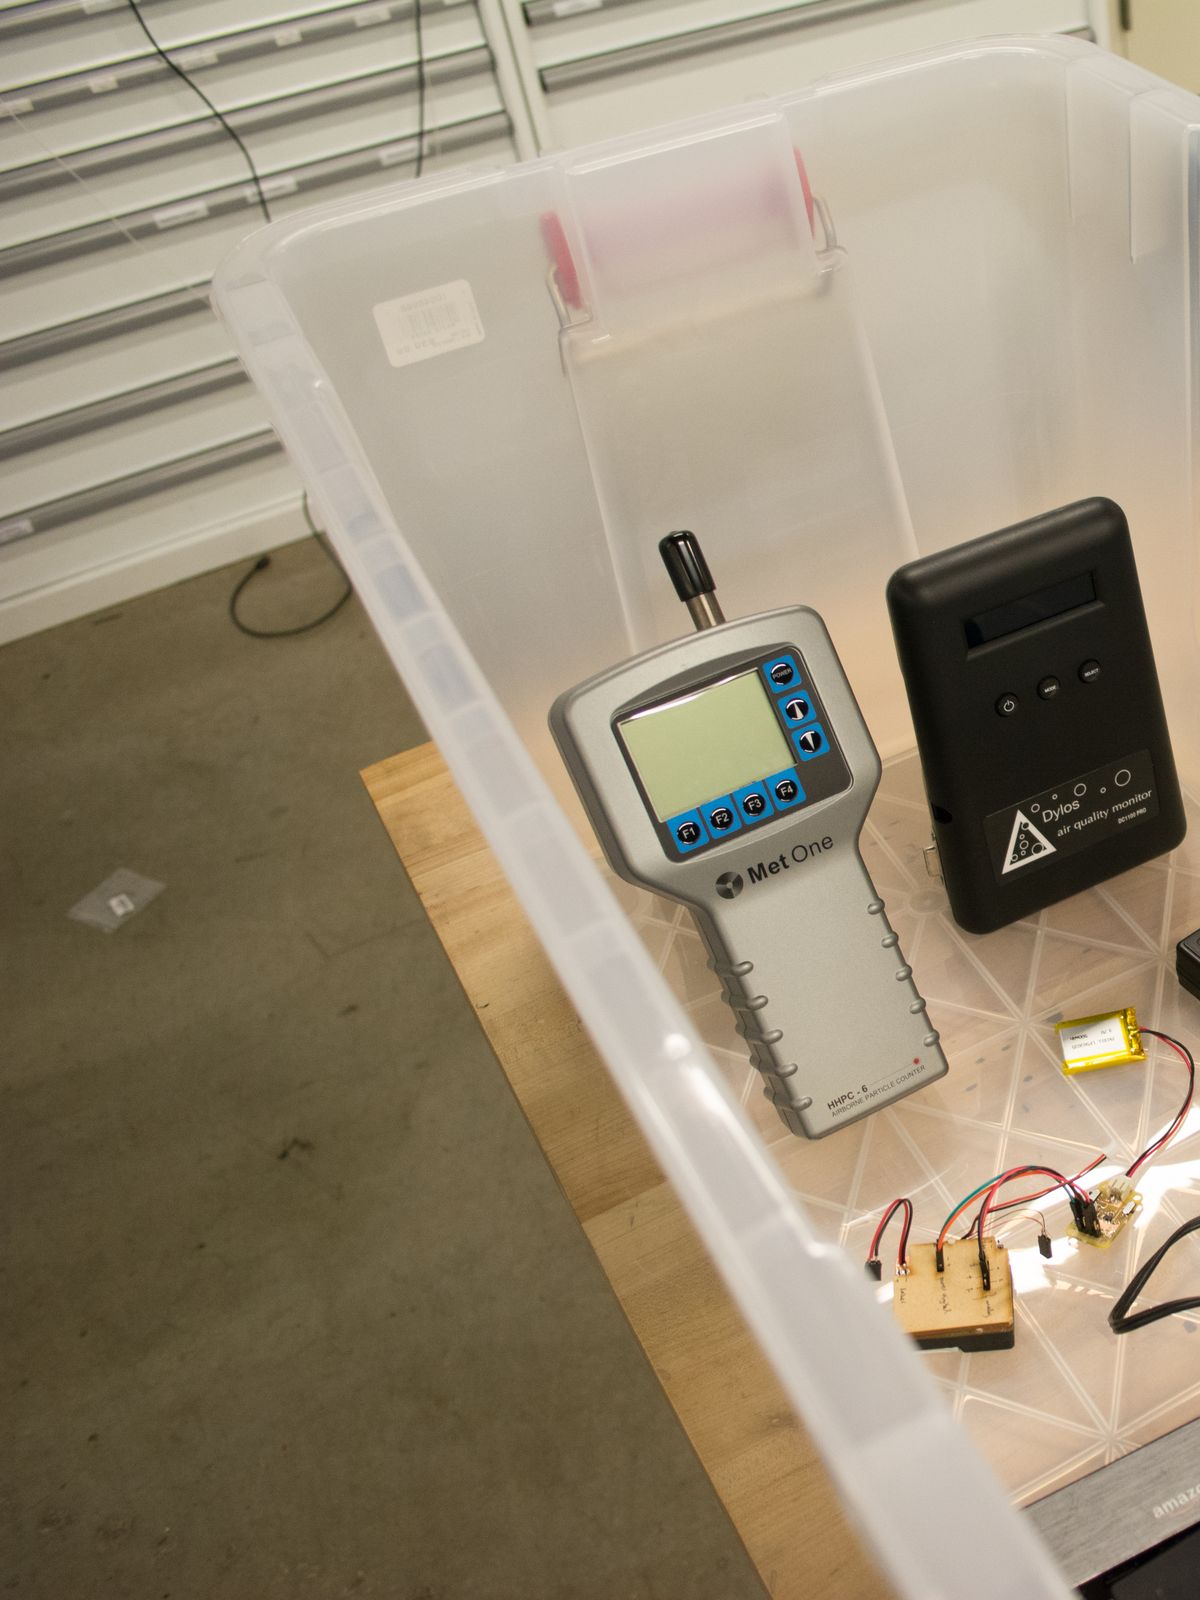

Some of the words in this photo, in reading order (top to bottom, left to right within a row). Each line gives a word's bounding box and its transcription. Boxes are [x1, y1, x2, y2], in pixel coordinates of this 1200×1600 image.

[771, 668, 793, 680] POWER
[1084, 668, 1099, 678] SELECT
[1044, 685, 1056, 693] MODE
[780, 784, 795, 797] F4
[748, 798, 762, 810] F3
[715, 812, 730, 825] F2
[1042, 800, 1080, 824] Dylos
[1057, 825, 1071, 837] air
[1074, 807, 1110, 832] quality
[1112, 789, 1152, 814] monitor
[682, 826, 696, 839] F1
[746, 854, 790, 885] Met
[791, 835, 834, 864] One
[827, 1091, 855, 1110] HHPC
[862, 1084, 868, 1093] 6
[832, 1098, 865, 1118] AIRBORNE
[864, 1080, 896, 1101] PARTICLE
[896, 1064, 926, 1084] COUNTER
